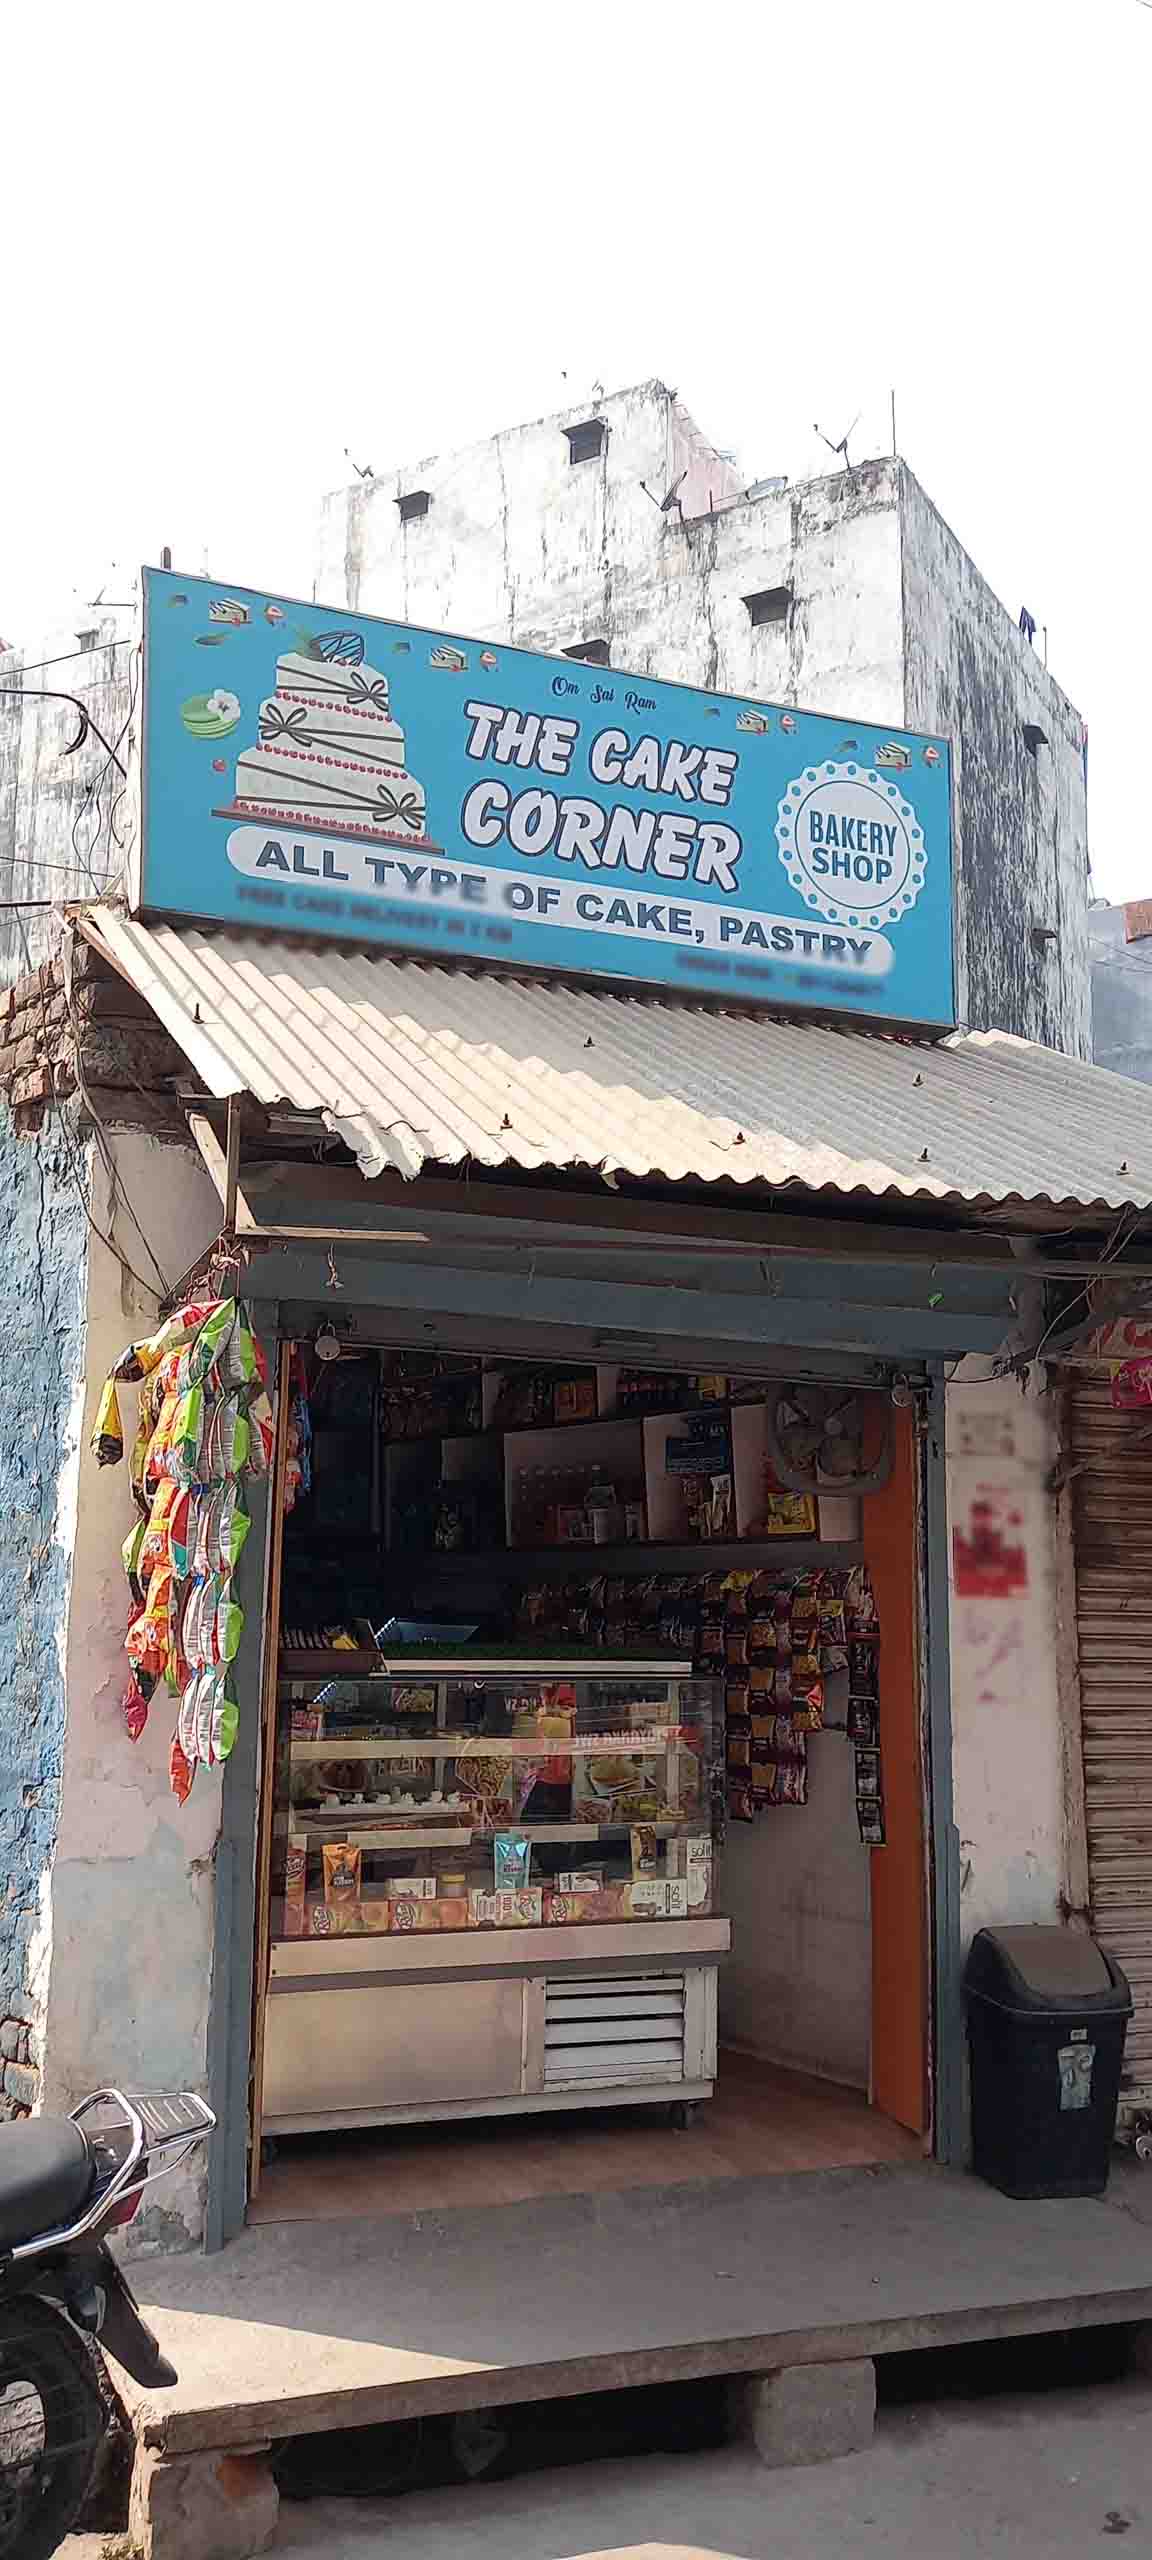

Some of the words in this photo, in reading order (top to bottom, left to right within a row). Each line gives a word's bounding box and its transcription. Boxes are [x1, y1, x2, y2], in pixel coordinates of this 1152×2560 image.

[552, 676, 580, 697] Om
[590, 684, 616, 704] Sai
[624, 691, 657, 715] Ram
[464, 700, 580, 775] THE
[589, 727, 738, 806] CAKE
[461, 778, 743, 893] CORNER
[810, 810, 898, 857] BAKERY
[811, 847, 893, 884] SHOP
[255, 840, 350, 881] ALL
[364, 857, 487, 900] TYPE
[504, 882, 561, 914] OF
[576, 894, 705, 944] CAKE,
[719, 916, 873, 965] PASTRY
